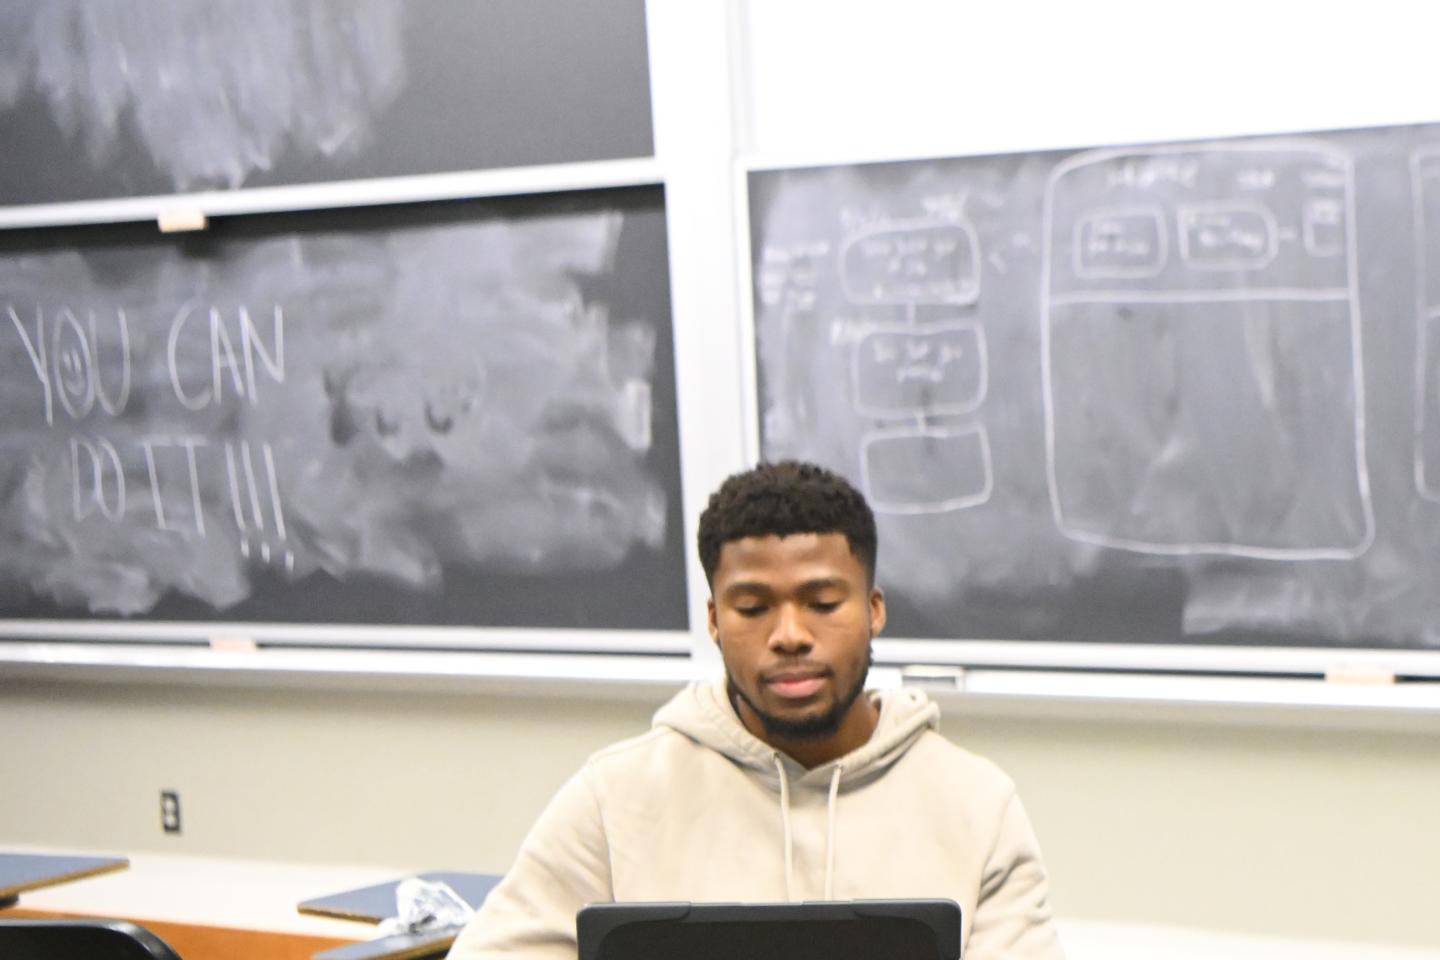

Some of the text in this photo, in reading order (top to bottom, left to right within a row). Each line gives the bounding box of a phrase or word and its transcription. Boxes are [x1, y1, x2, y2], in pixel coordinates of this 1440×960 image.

[8, 299, 286, 427] YOU CAN
[70, 435, 126, 523] DO
